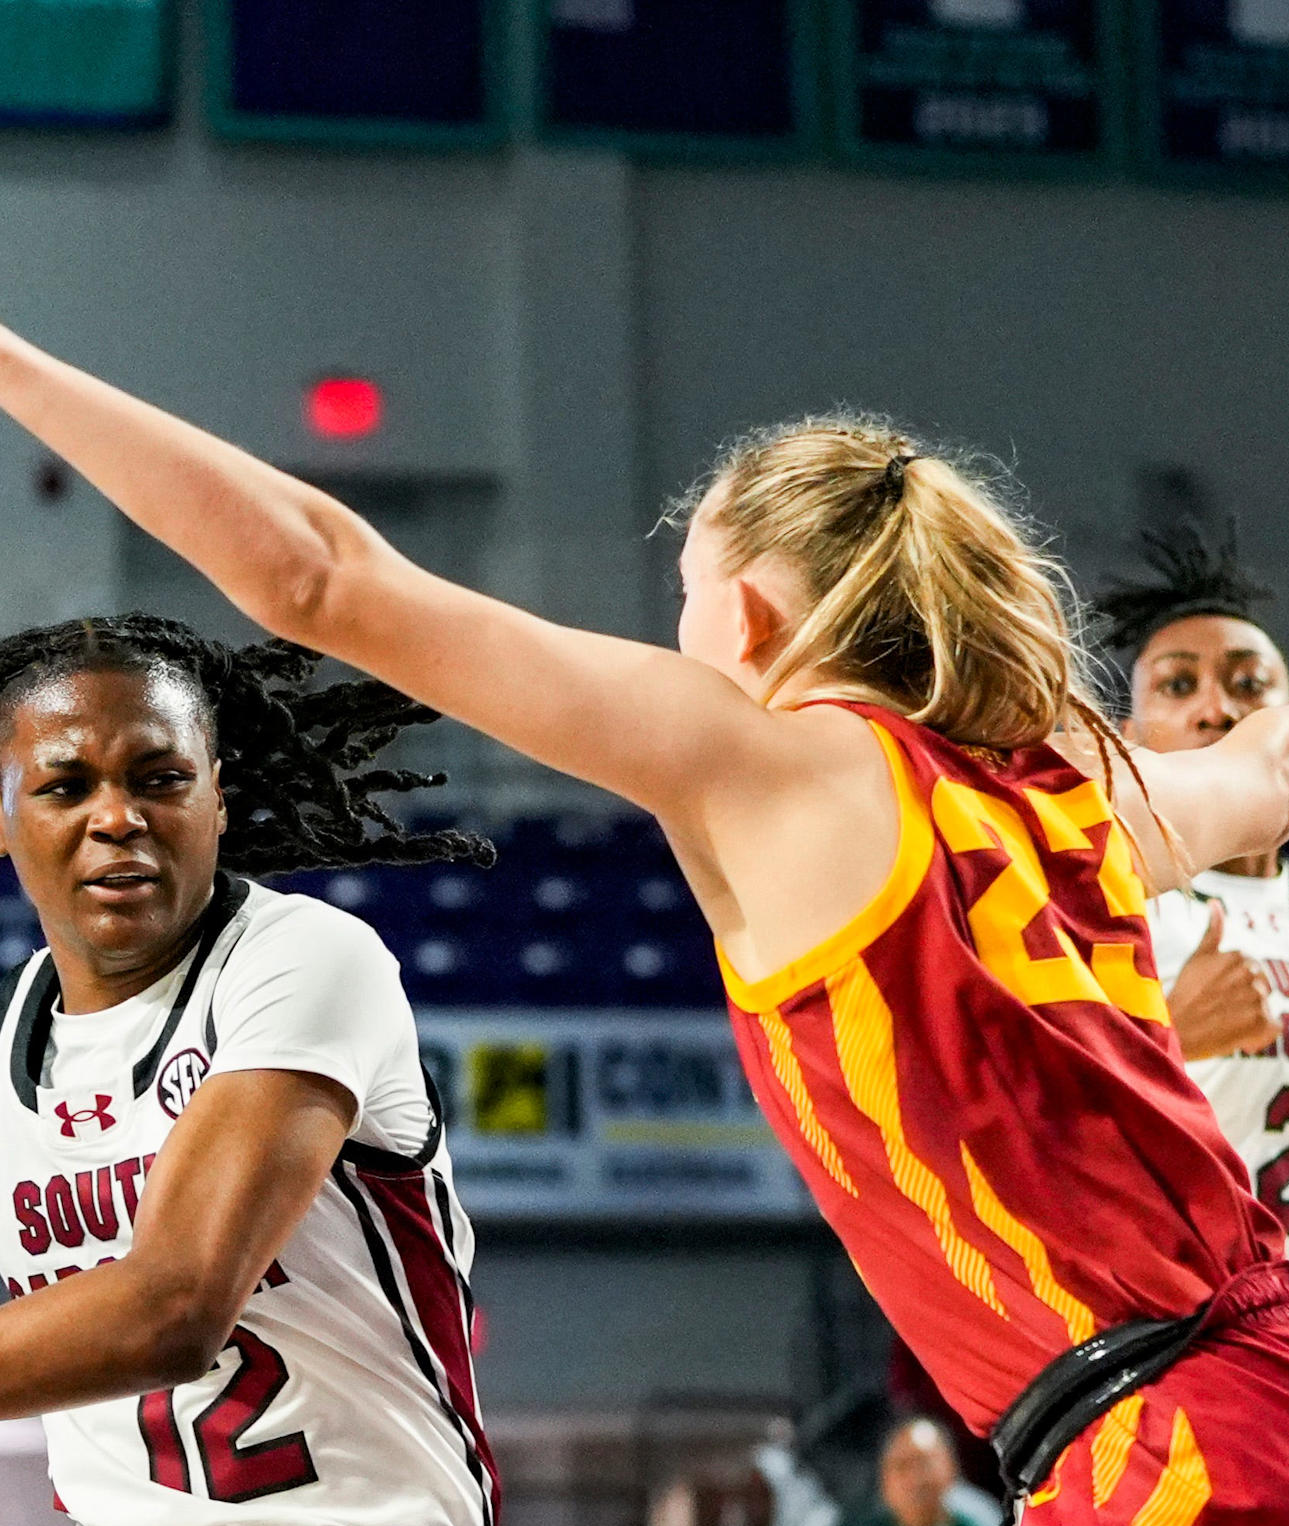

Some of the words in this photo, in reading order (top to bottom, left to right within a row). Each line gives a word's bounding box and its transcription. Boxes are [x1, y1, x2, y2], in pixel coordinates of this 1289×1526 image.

[932, 776, 1171, 1027] 23
[13, 1152, 157, 1256] SOUT
[137, 1325, 319, 1504] 12
